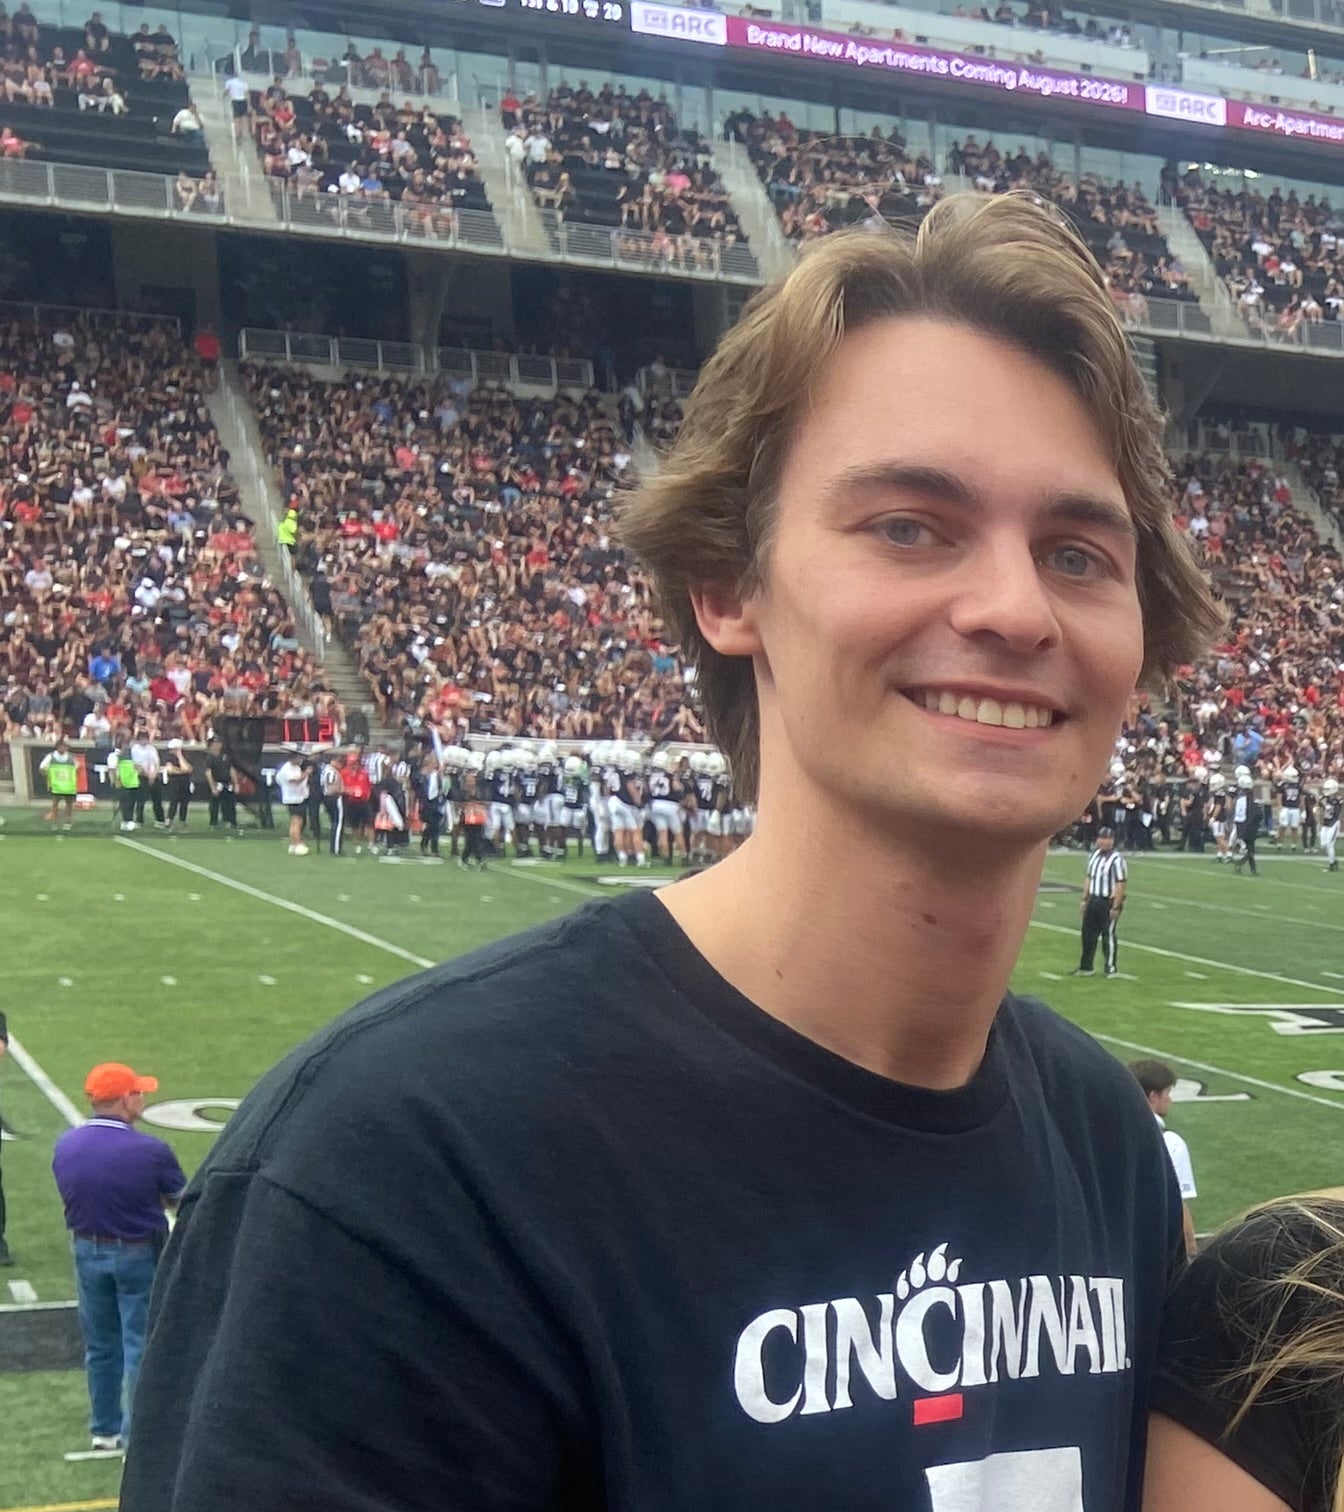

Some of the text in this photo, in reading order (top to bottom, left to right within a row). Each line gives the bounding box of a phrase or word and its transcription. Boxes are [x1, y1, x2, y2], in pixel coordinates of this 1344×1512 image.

[671, 13, 716, 37] ARC
[747, 25, 802, 50] Brand
[803, 35, 844, 57] New
[845, 41, 949, 75] Apartments
[950, 58, 1017, 90] Coming
[1018, 69, 1079, 95] August
[1178, 98, 1217, 119] ARC
